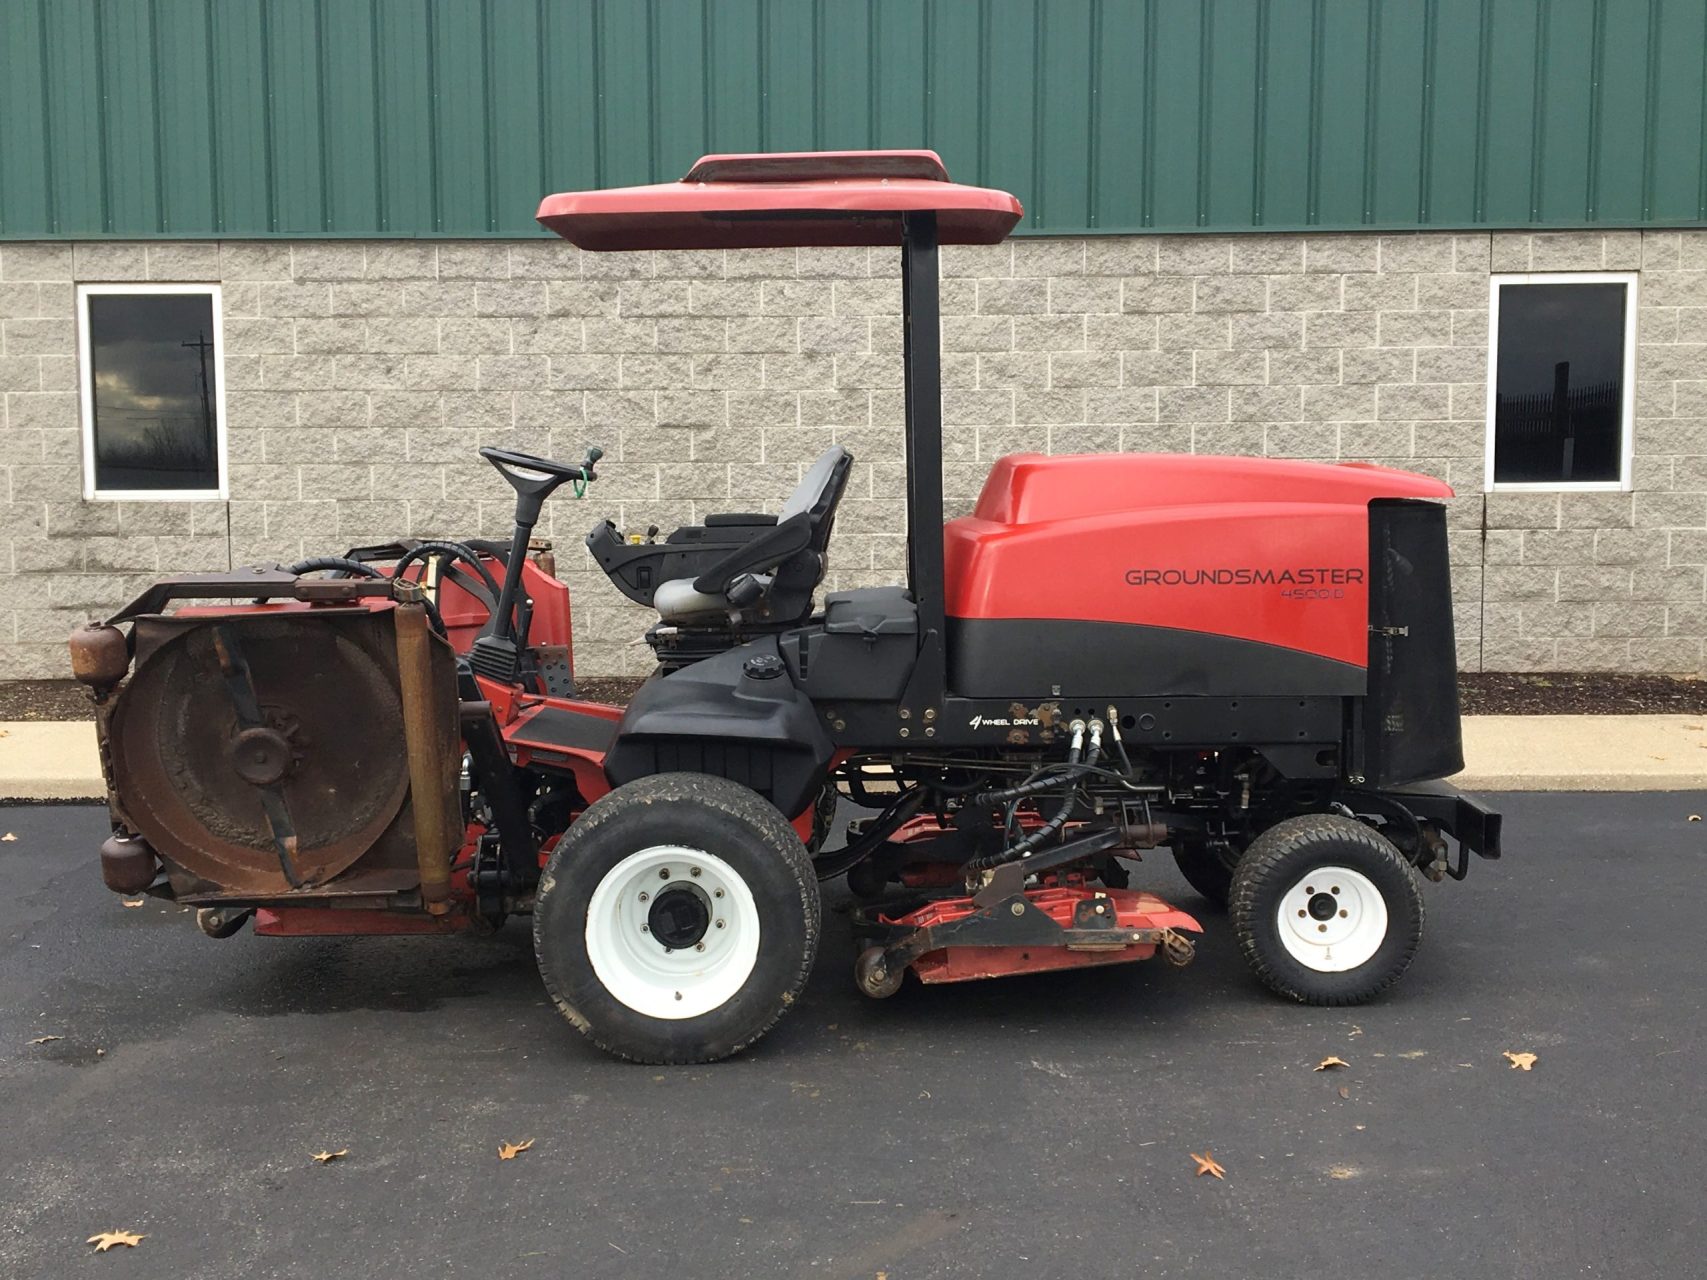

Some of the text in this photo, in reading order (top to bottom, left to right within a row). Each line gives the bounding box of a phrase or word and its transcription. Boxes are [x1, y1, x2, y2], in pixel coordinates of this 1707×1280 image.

[1125, 569, 1364, 586] GROUNDSMASTER
[969, 715, 982, 730] 4
[1013, 718, 1039, 726] DRIVE
